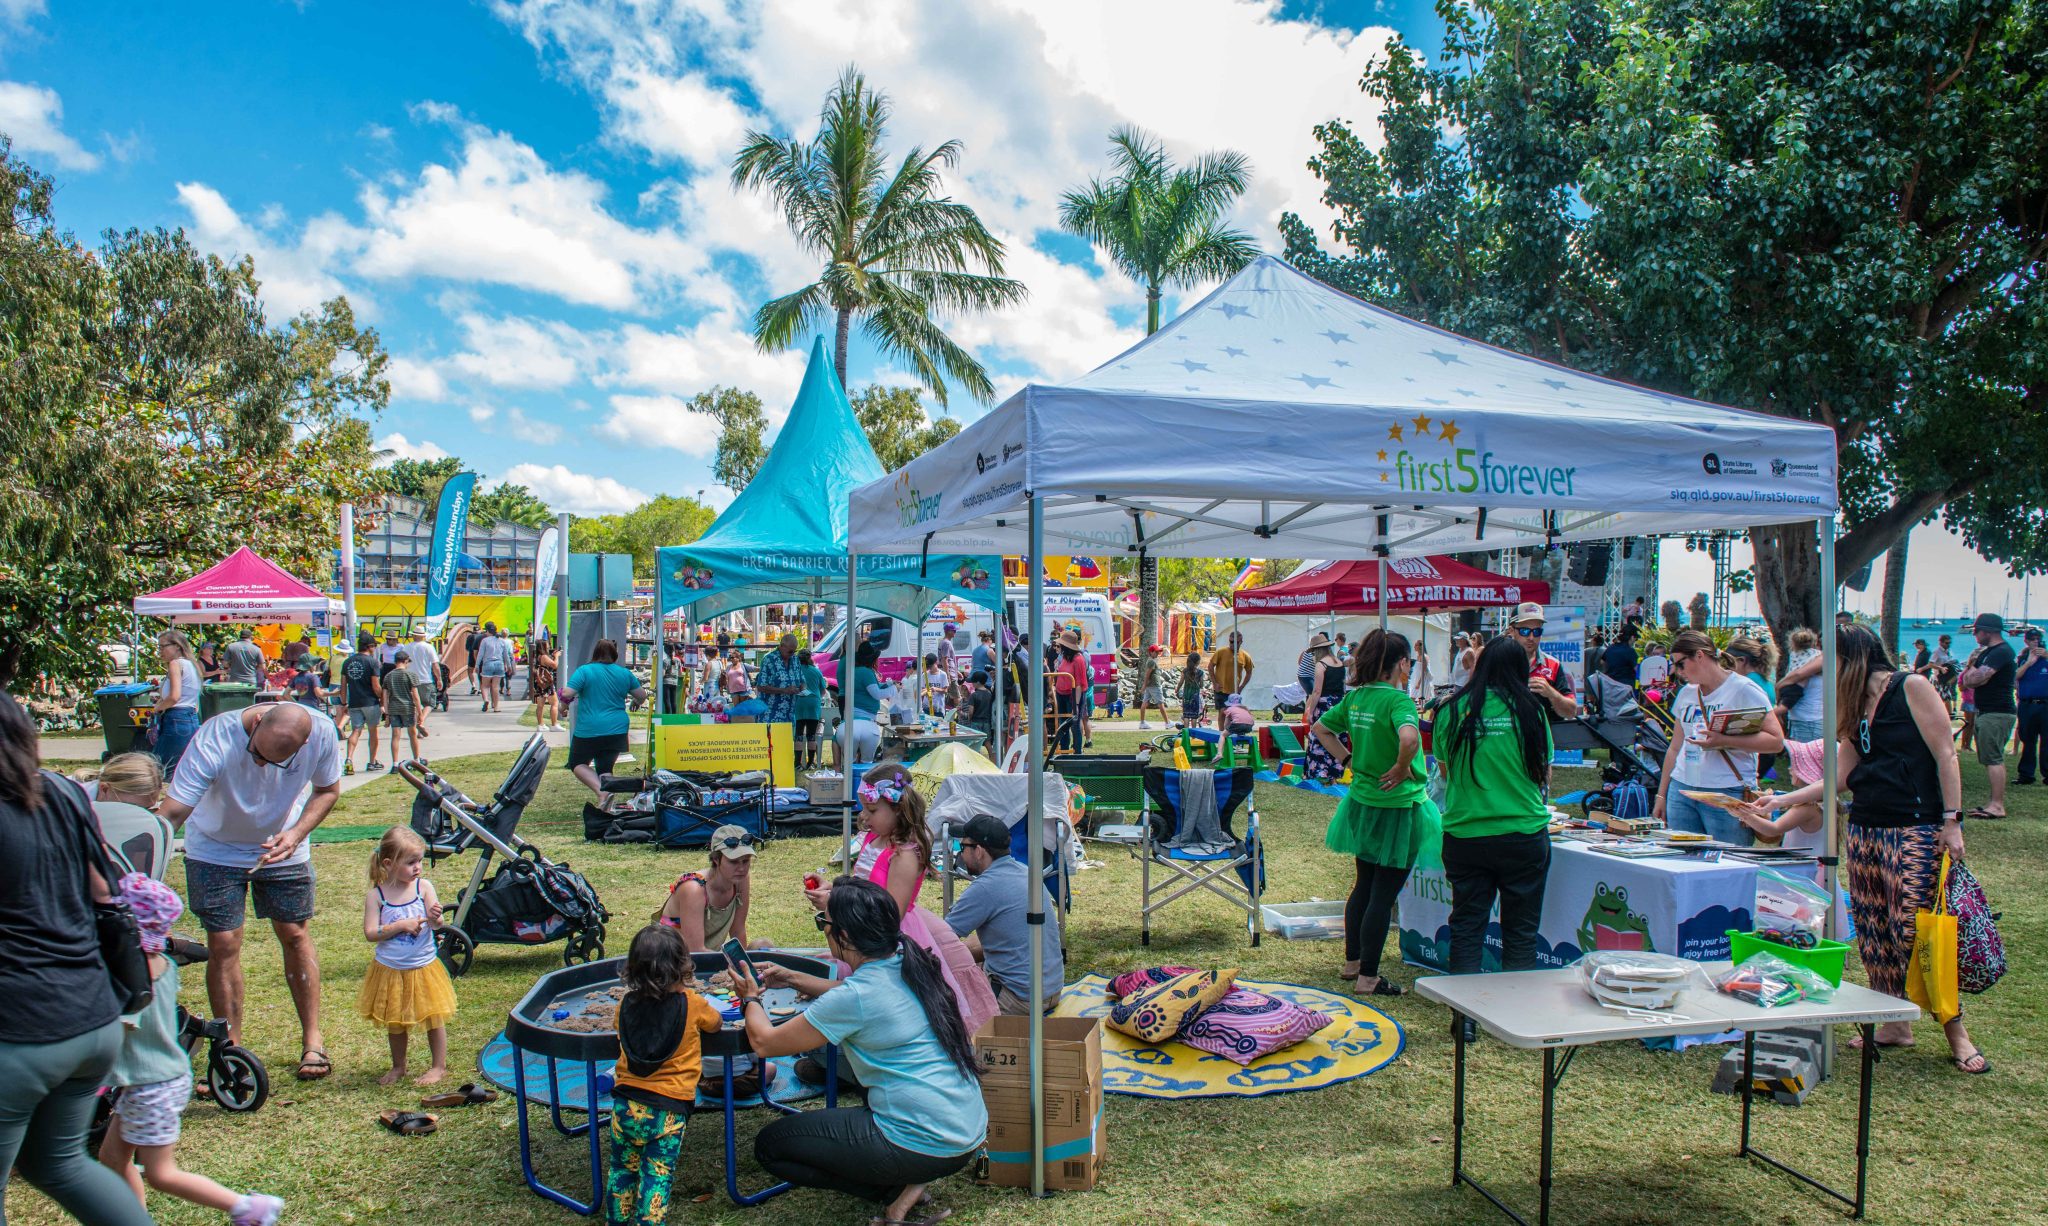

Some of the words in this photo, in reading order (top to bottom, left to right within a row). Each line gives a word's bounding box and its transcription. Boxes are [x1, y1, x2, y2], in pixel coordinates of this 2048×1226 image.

[1736, 461, 1753, 469] Library
[1788, 463, 1818, 471] Queensland
[1395, 448, 1576, 496] first5forever
[1670, 488, 1821, 505] slq.qld.gov.au/first5forever
[441, 490, 464, 586] CruiseWhitsundays
[742, 553, 783, 572] GREAT
[782, 555, 837, 573] BARRIER
[871, 554, 922, 569] FESTIVAL
[1362, 587, 1377, 603] IT
[1405, 585, 1461, 601] STARTS
[206, 600, 246, 609] Bendigo
[248, 601, 272, 609] Bank
[1551, 651, 1581, 662] STICS
[1700, 938, 1718, 948] your
[1419, 944, 1439, 961] Talk
[1704, 948, 1719, 957] free
[1000, 1053, 1017, 1066] 28
